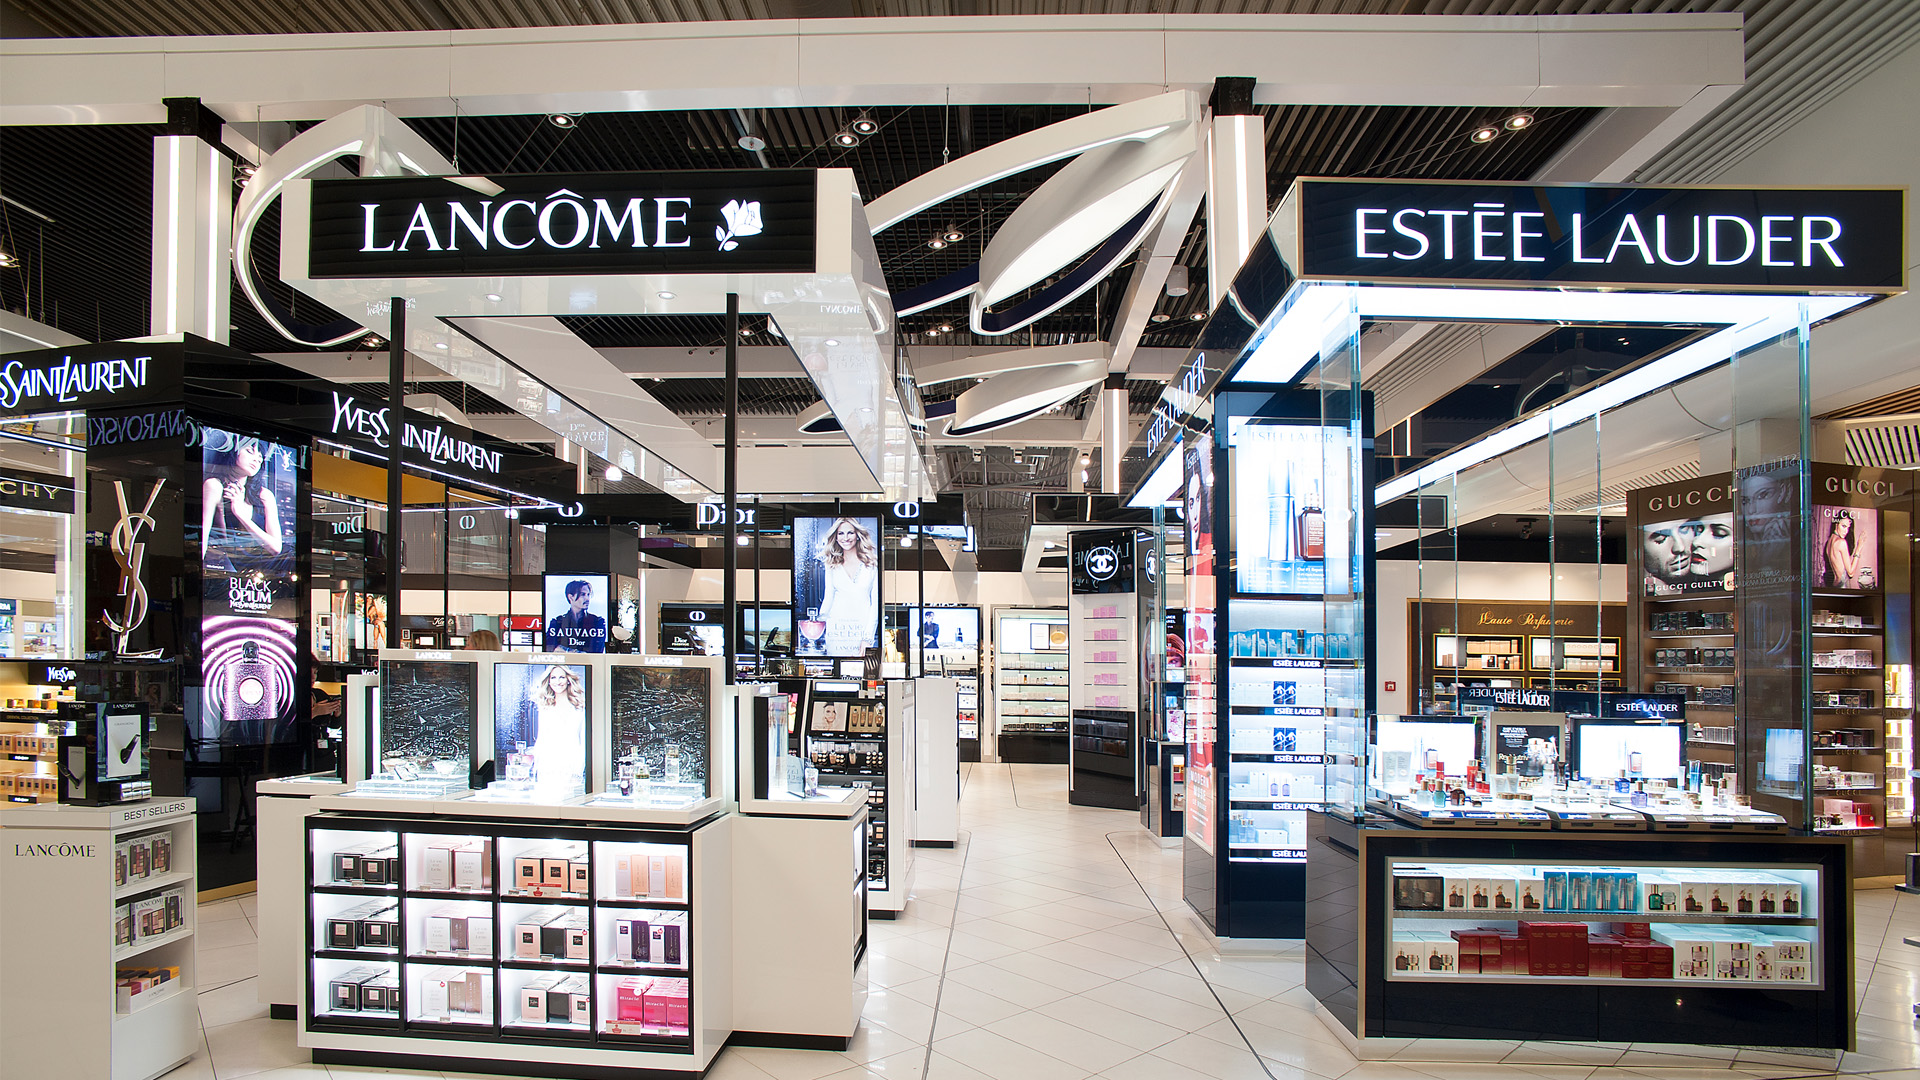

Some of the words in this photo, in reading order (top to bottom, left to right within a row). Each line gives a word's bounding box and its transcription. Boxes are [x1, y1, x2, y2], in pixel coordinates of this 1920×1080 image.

[359, 188, 692, 252] LANCÔME
[1572, 213, 1845, 267] LAUDER
[1825, 476, 1895, 497] GUCCI
[1648, 485, 1734, 512] GUCCI
[699, 503, 756, 525] Dior
[1824, 508, 1862, 520] GUCCI
[229, 577, 272, 592] BLACK
[1655, 583, 1688, 592] GUCCI
[1690, 580, 1725, 589] GUILTY
[229, 589, 272, 603] OPIUM
[549, 627, 605, 638] SAUVAGE
[568, 637, 586, 646] Dior
[1293, 660, 1321, 668] LAUDER
[1517, 694, 1551, 707] LAUDER
[1294, 707, 1322, 715] LAUDER
[1642, 703, 1679, 713] LAUDER
[1294, 755, 1322, 763] LAUDER
[123, 808, 147, 821] BEST
[149, 802, 186, 816] SELLERS
[14, 841, 96, 858] LANCÔME
